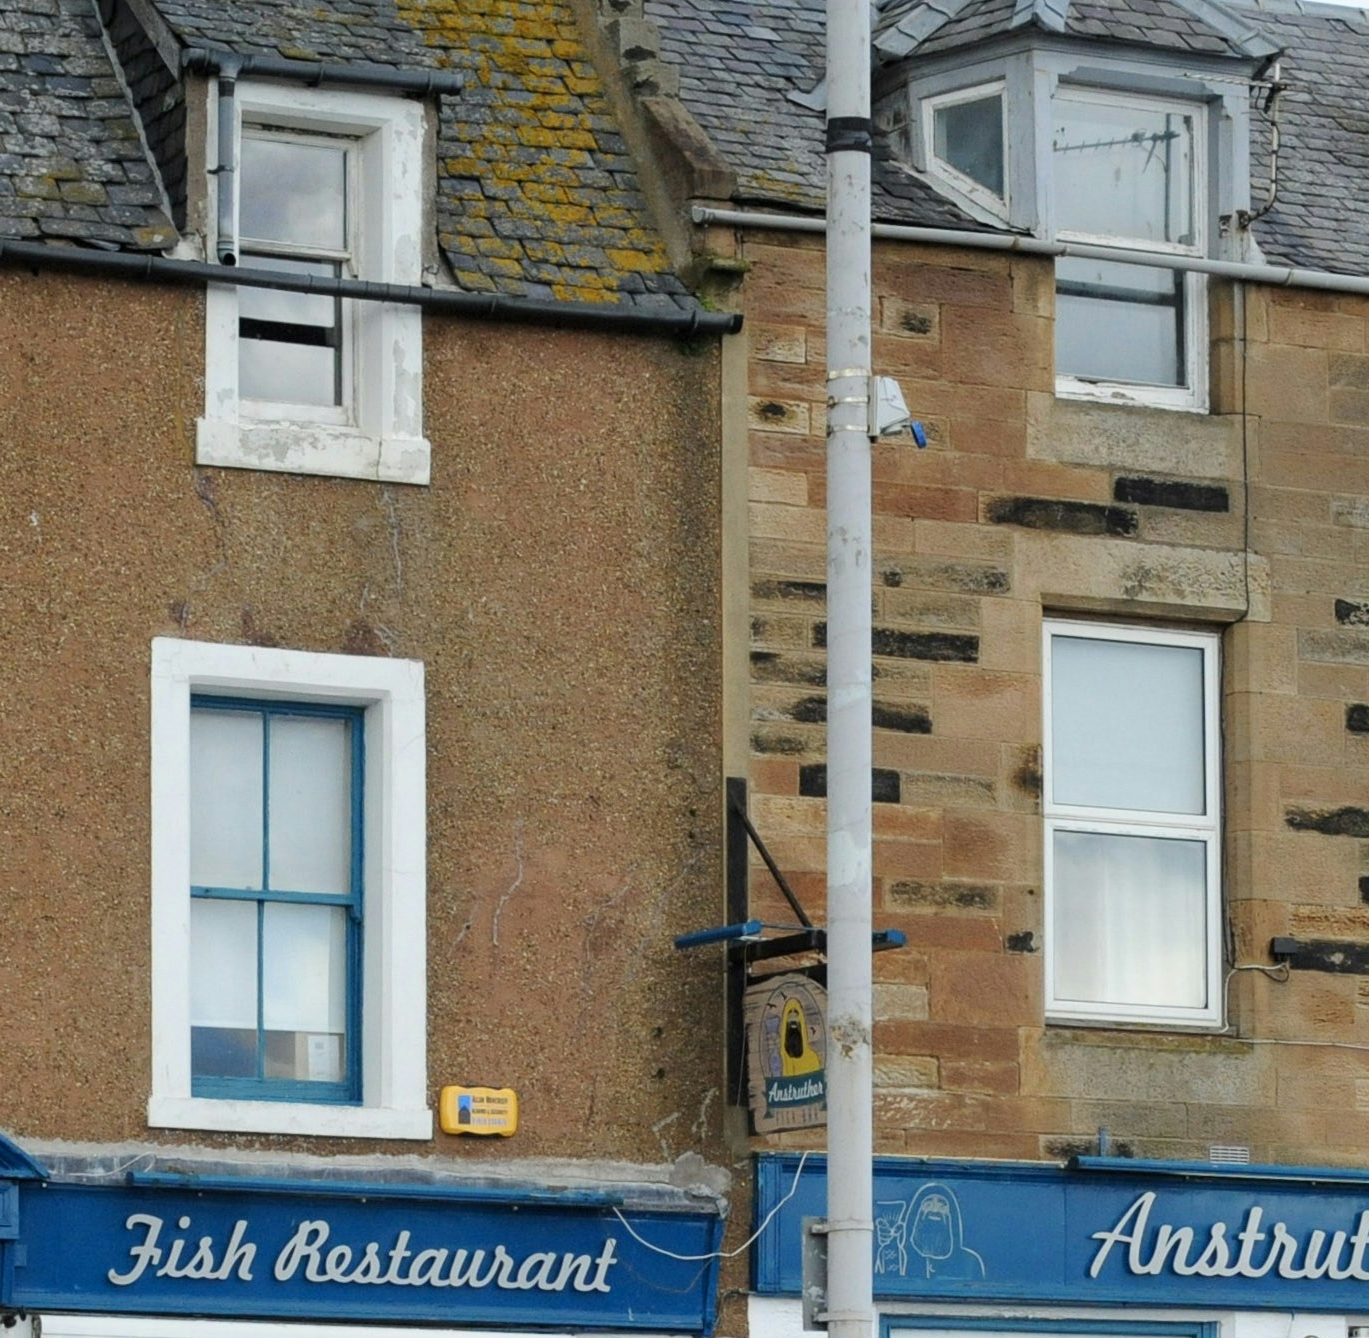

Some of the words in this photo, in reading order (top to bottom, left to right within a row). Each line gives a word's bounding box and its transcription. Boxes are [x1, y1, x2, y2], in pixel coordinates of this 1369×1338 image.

[768, 1079, 823, 1103] Anstruther
[108, 1214, 257, 1285] Fish
[274, 1219, 619, 1292] Restaurant
